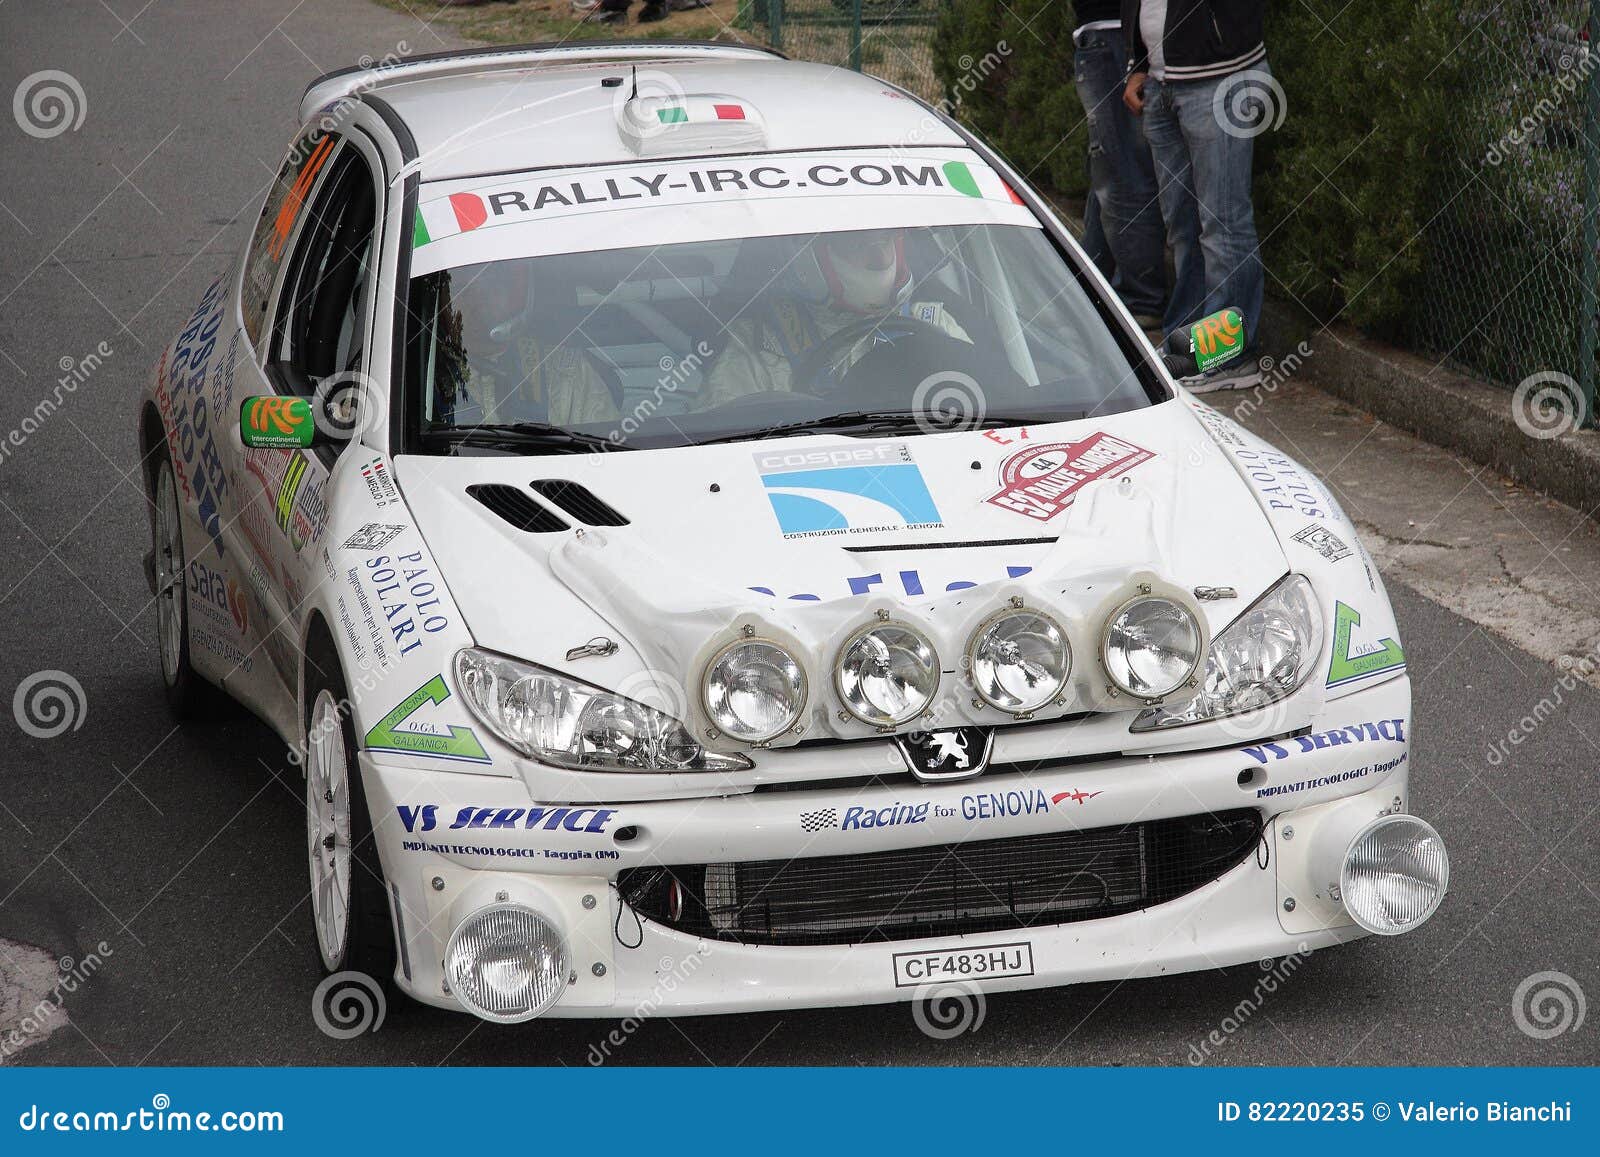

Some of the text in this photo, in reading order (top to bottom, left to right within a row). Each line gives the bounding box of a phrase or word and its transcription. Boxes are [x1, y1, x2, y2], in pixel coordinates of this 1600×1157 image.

[487, 164, 944, 216] RALLY-IRC.COM
[1195, 310, 1241, 354] IRC
[250, 397, 305, 434] IRC
[251, 435, 301, 443] Intercontinental
[761, 444, 892, 469] cospef
[1023, 467, 1088, 501] RALLYE
[1069, 435, 1140, 474] SANREMO
[1031, 457, 1058, 471] 44
[1235, 450, 1295, 512] PAOLO
[1261, 450, 1325, 520] SOLARI
[783, 528, 848, 540] COSTRUZIONI
[849, 525, 900, 535] GENERALE
[906, 522, 945, 531] GENOVA
[191, 560, 228, 612] sara
[397, 551, 448, 633] PAOLO
[363, 613, 376, 630] per
[366, 555, 423, 658] SOLARI
[370, 626, 381, 639] la
[373, 635, 391, 668] Liguria
[1352, 655, 1390, 672] GALVANICA
[386, 690, 429, 727] OFFICINA
[393, 735, 449, 751] GALVANICA
[1240, 718, 1406, 765] VS SERVICE
[1257, 781, 1305, 799] IMPIANTI
[1307, 766, 1368, 790] TECNOLOGICI
[396, 804, 619, 834] VS SERVICE
[841, 789, 1049, 831] Racing for GENOVA
[402, 841, 450, 854] IMPIANTI
[451, 843, 535, 858] TECNOLOGICI
[543, 849, 592, 860] Taggia
[594, 849, 620, 861] (IM)
[905, 950, 1022, 979] CF483HJ
